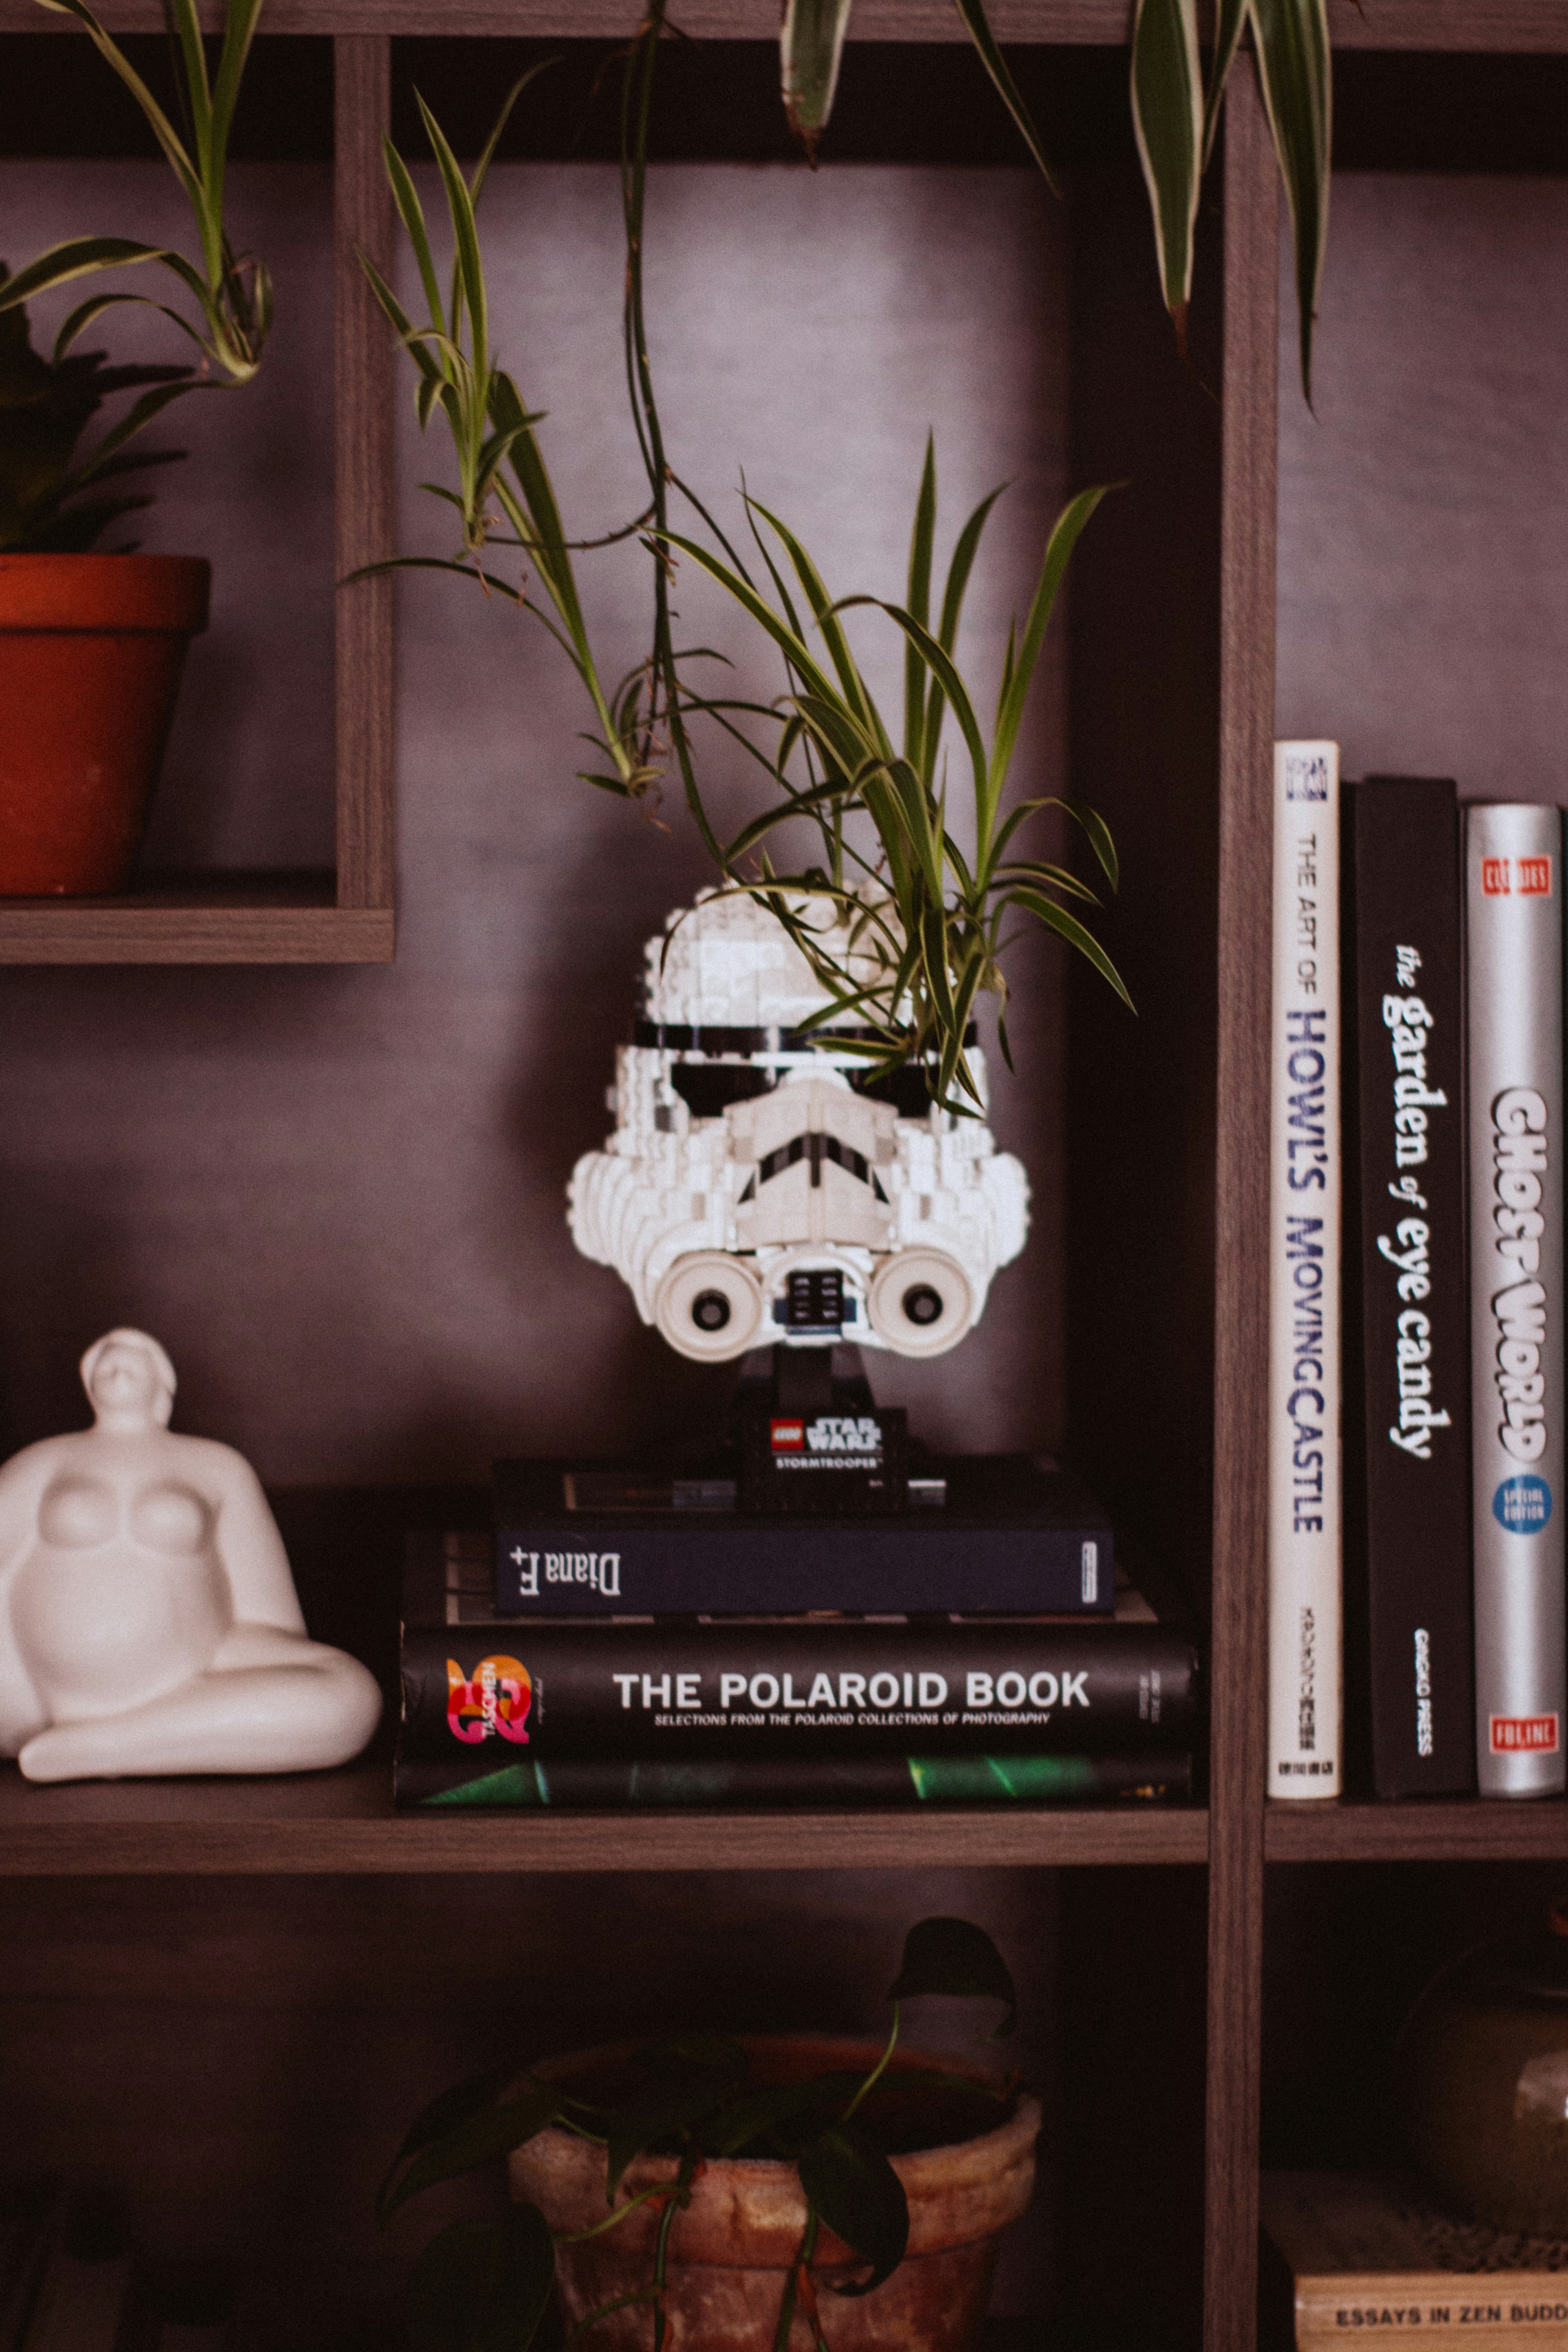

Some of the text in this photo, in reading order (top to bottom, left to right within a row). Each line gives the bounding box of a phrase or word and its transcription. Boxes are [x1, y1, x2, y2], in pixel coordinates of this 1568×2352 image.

[1298, 833, 1316, 887] THE
[1298, 897, 1316, 951] ART
[1298, 959, 1316, 994] OF
[1286, 1009, 1328, 1192] HOWL'S
[1377, 945, 1452, 1460] the garden of eye candy
[1491, 1087, 1547, 1462] GHOST WORLD
[807, 1417, 881, 1435] STAR
[807, 1433, 881, 1451] WARS
[776, 1457, 877, 1469] STORMTROOPER
[545, 1552, 621, 1595] Diana
[612, 1670, 1090, 1708] THE POLAROID BOOK
[654, 1712, 1051, 1726] SELECTIONS FROM THE POLAROID COLLECTIONS OF PHOTOGRAPHY
[1336, 2307, 1422, 2327] ESSAYS
[1429, 2306, 1450, 2324] IN
[1458, 2305, 1502, 2324] ZEN
